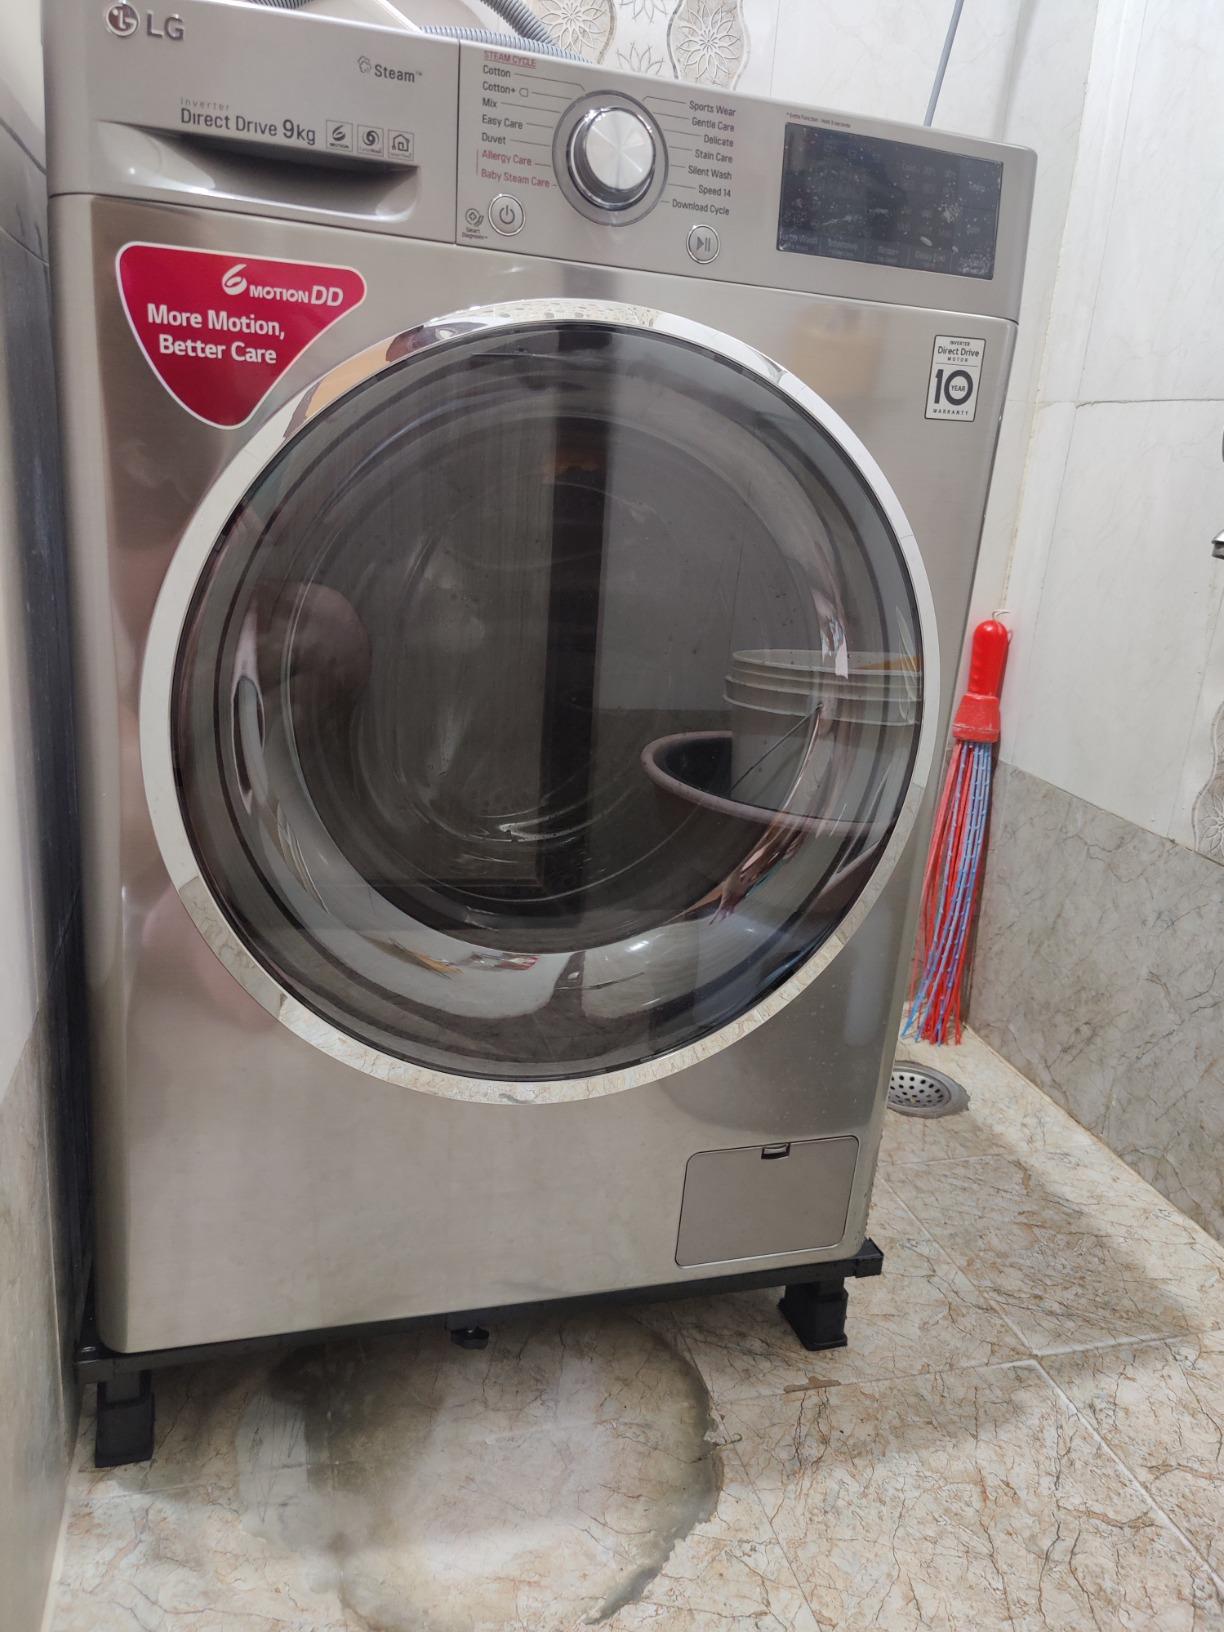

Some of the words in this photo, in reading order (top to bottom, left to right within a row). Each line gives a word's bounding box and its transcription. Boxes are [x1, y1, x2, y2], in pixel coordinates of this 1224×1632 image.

[147, 11, 185, 41] LG
[484, 50, 511, 61] STEAM
[513, 54, 536, 67] CYCLE
[483, 65, 511, 78] Cotton
[482, 81, 516, 94] Cotton+
[482, 98, 497, 108] Mix
[689, 100, 714, 113] Sports
[716, 105, 736, 116] Wear
[181, 107, 231, 130] Direct
[235, 115, 278, 137] Drive
[283, 119, 316, 145] 9kg
[482, 114, 502, 127] Easy
[504, 118, 523, 129] Care
[692, 117, 716, 129] Gentle
[718, 121, 735, 132] Care
[481, 132, 506, 145] Duvet
[704, 134, 734, 147] Delicate
[482, 149, 511, 164] Allergy
[513, 154, 532, 166] Care
[695, 149, 714, 160] Stain
[716, 152, 733, 163] Care
[481, 168, 502, 182] Baby
[504, 172, 529, 184] Steam
[531, 177, 550, 188] Care
[688, 165, 709, 176] Silent
[711, 168, 732, 180] Wash
[698, 185, 722, 197] Speed
[723, 189, 731, 198] 14
[672, 199, 709, 213] Download
[709, 204, 730, 215] Cycle
[147, 303, 202, 328] More
[207, 309, 285, 340] Motion,
[158, 334, 226, 359] Better
[231, 341, 277, 364] Care
[937, 345, 959, 356] Direct
[960, 348, 979, 358] Drive
[934, 368, 974, 406] 10
[951, 384, 966, 392] YEAR
[932, 408, 968, 416] WARRANTY
